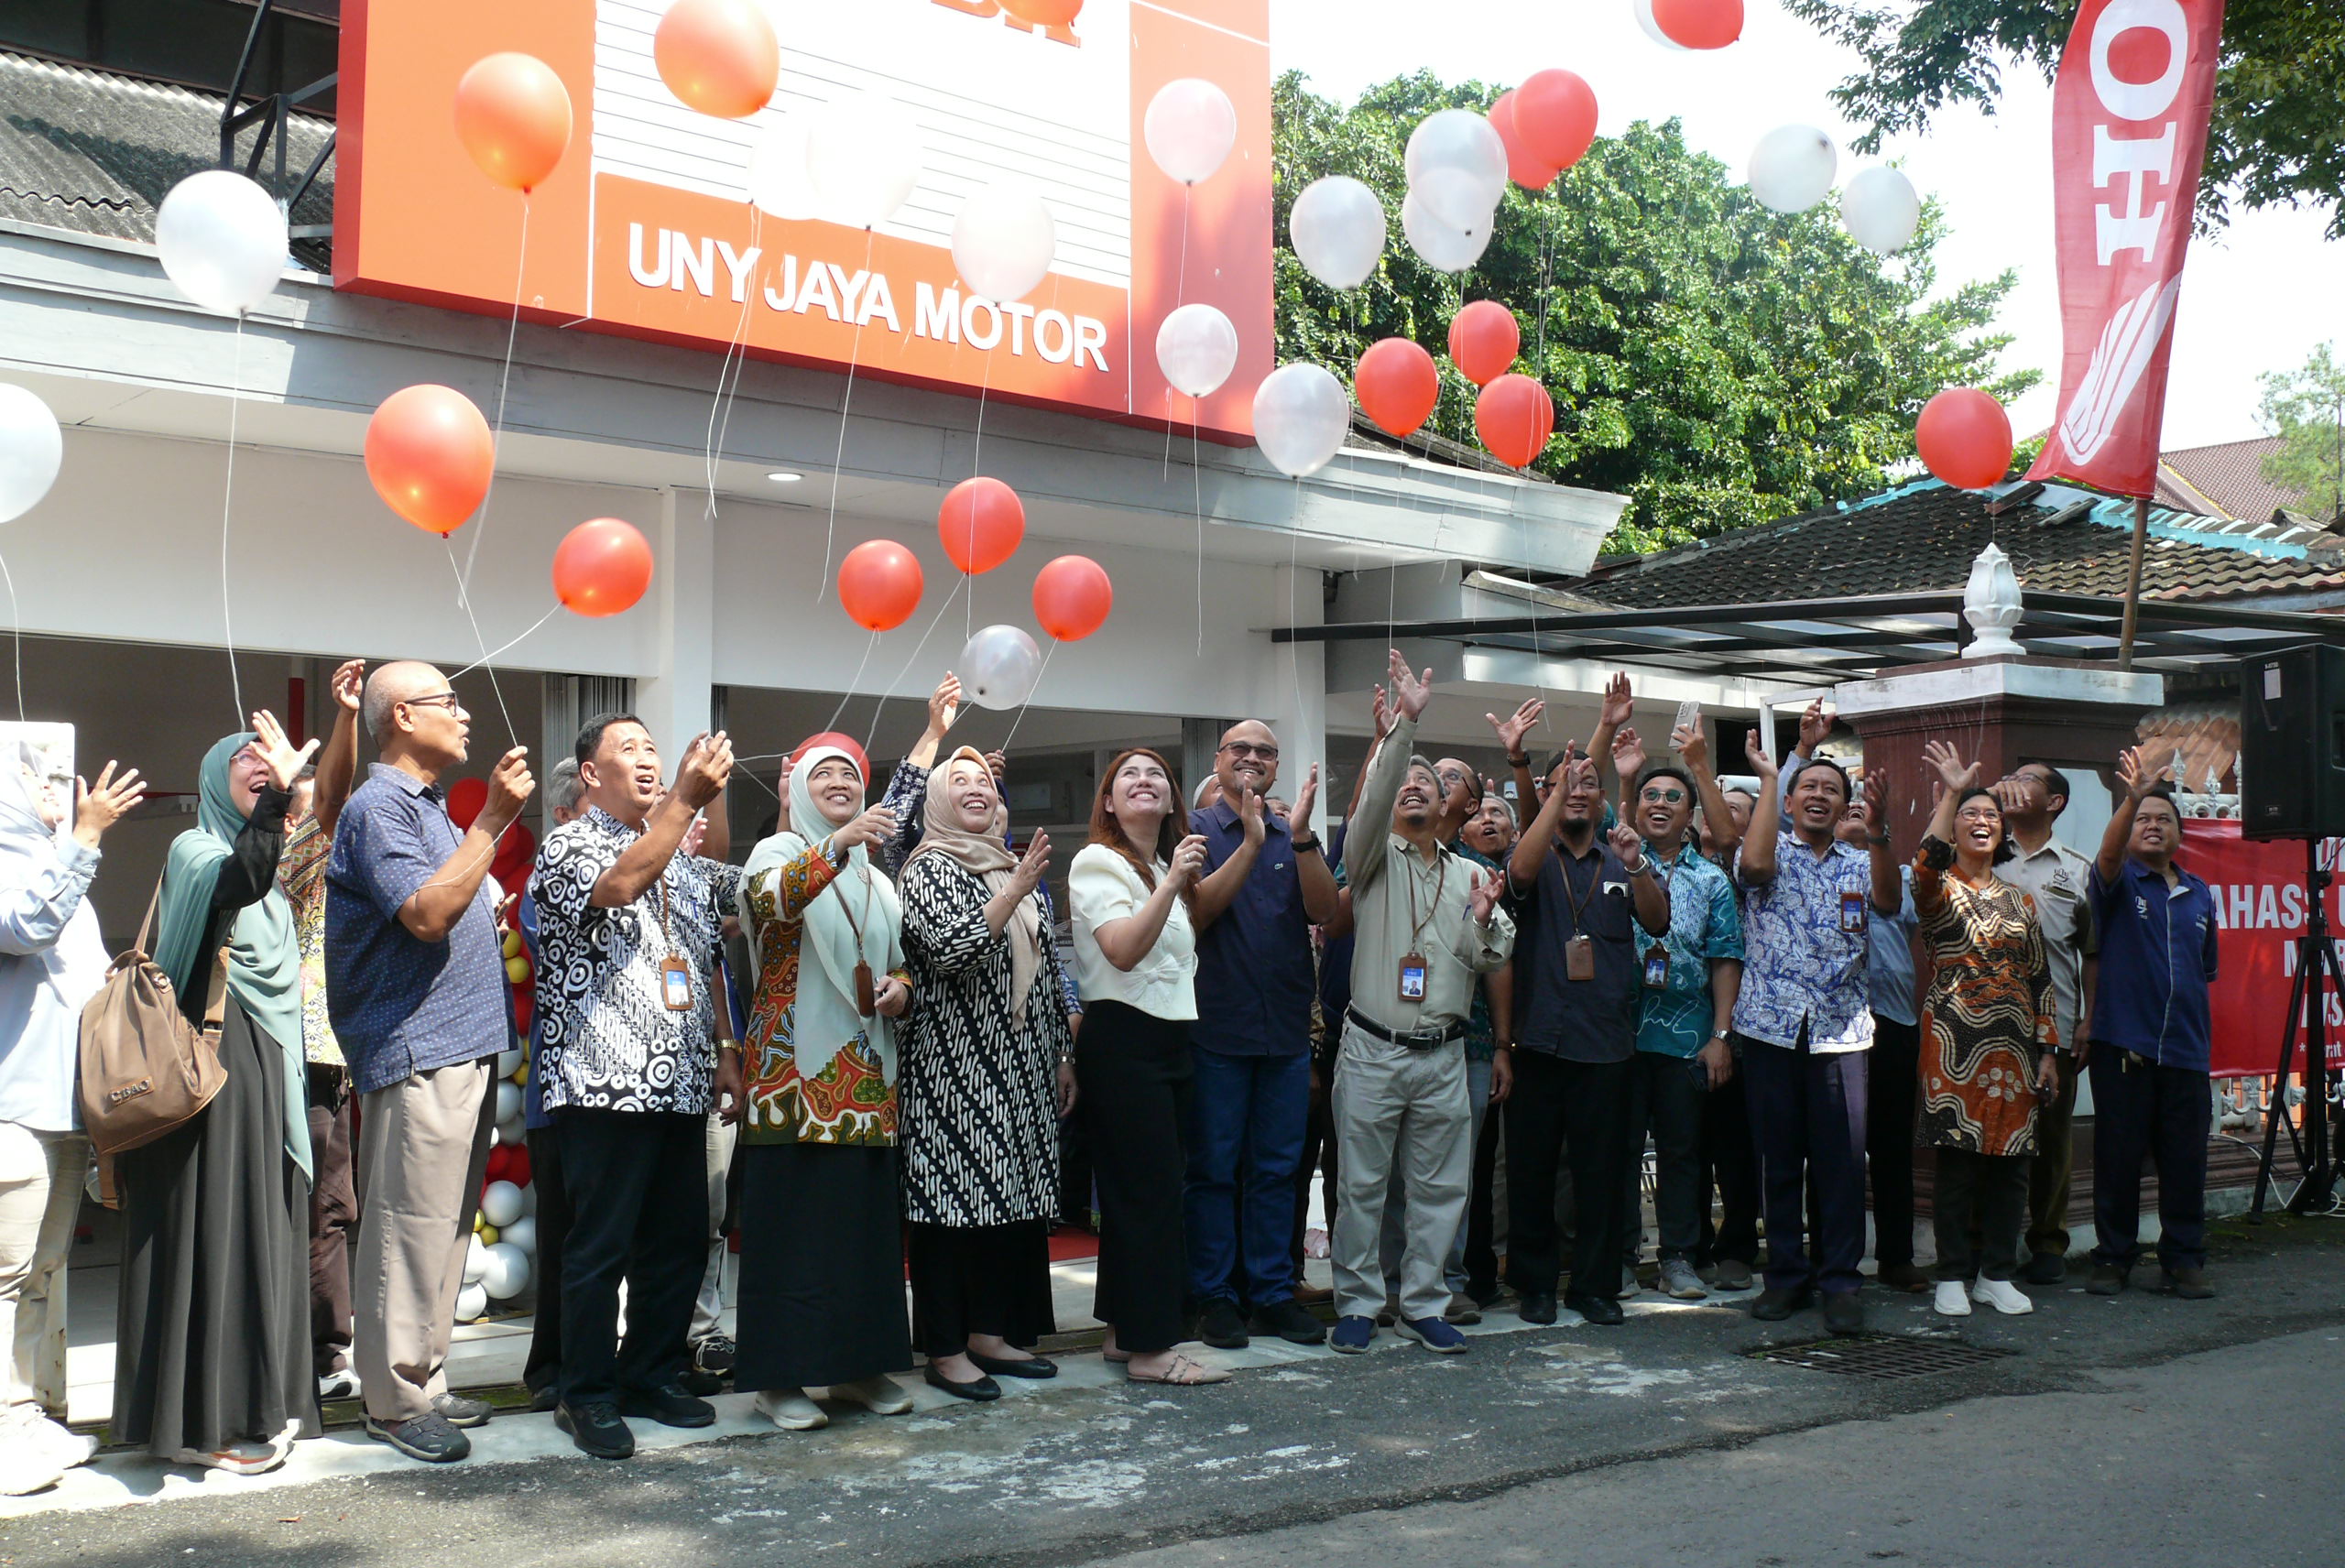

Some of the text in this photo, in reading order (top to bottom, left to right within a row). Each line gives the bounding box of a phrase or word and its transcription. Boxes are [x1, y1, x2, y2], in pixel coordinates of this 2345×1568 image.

[627, 223, 1109, 372] UNY JAYA MOTOR
